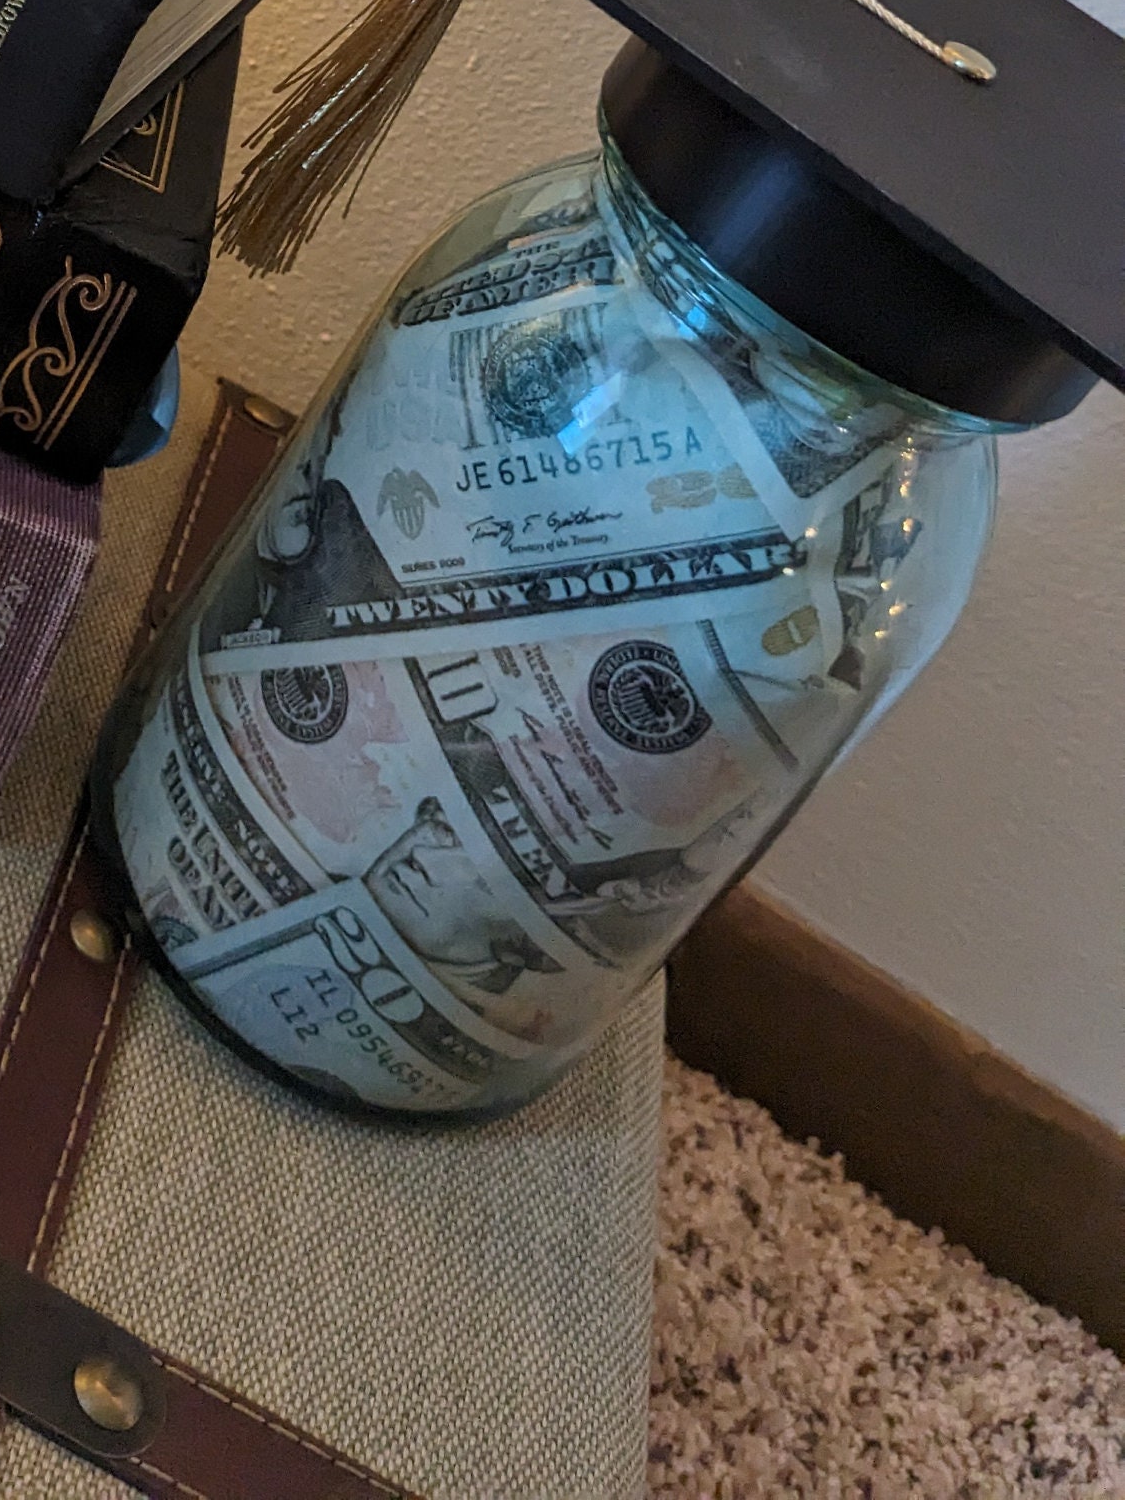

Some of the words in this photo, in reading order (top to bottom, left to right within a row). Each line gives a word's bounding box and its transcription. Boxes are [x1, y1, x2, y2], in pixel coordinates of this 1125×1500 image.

[329, 583, 527, 629] TWENTY
[486, 786, 583, 900] TEN
[313, 904, 426, 1025] 20
